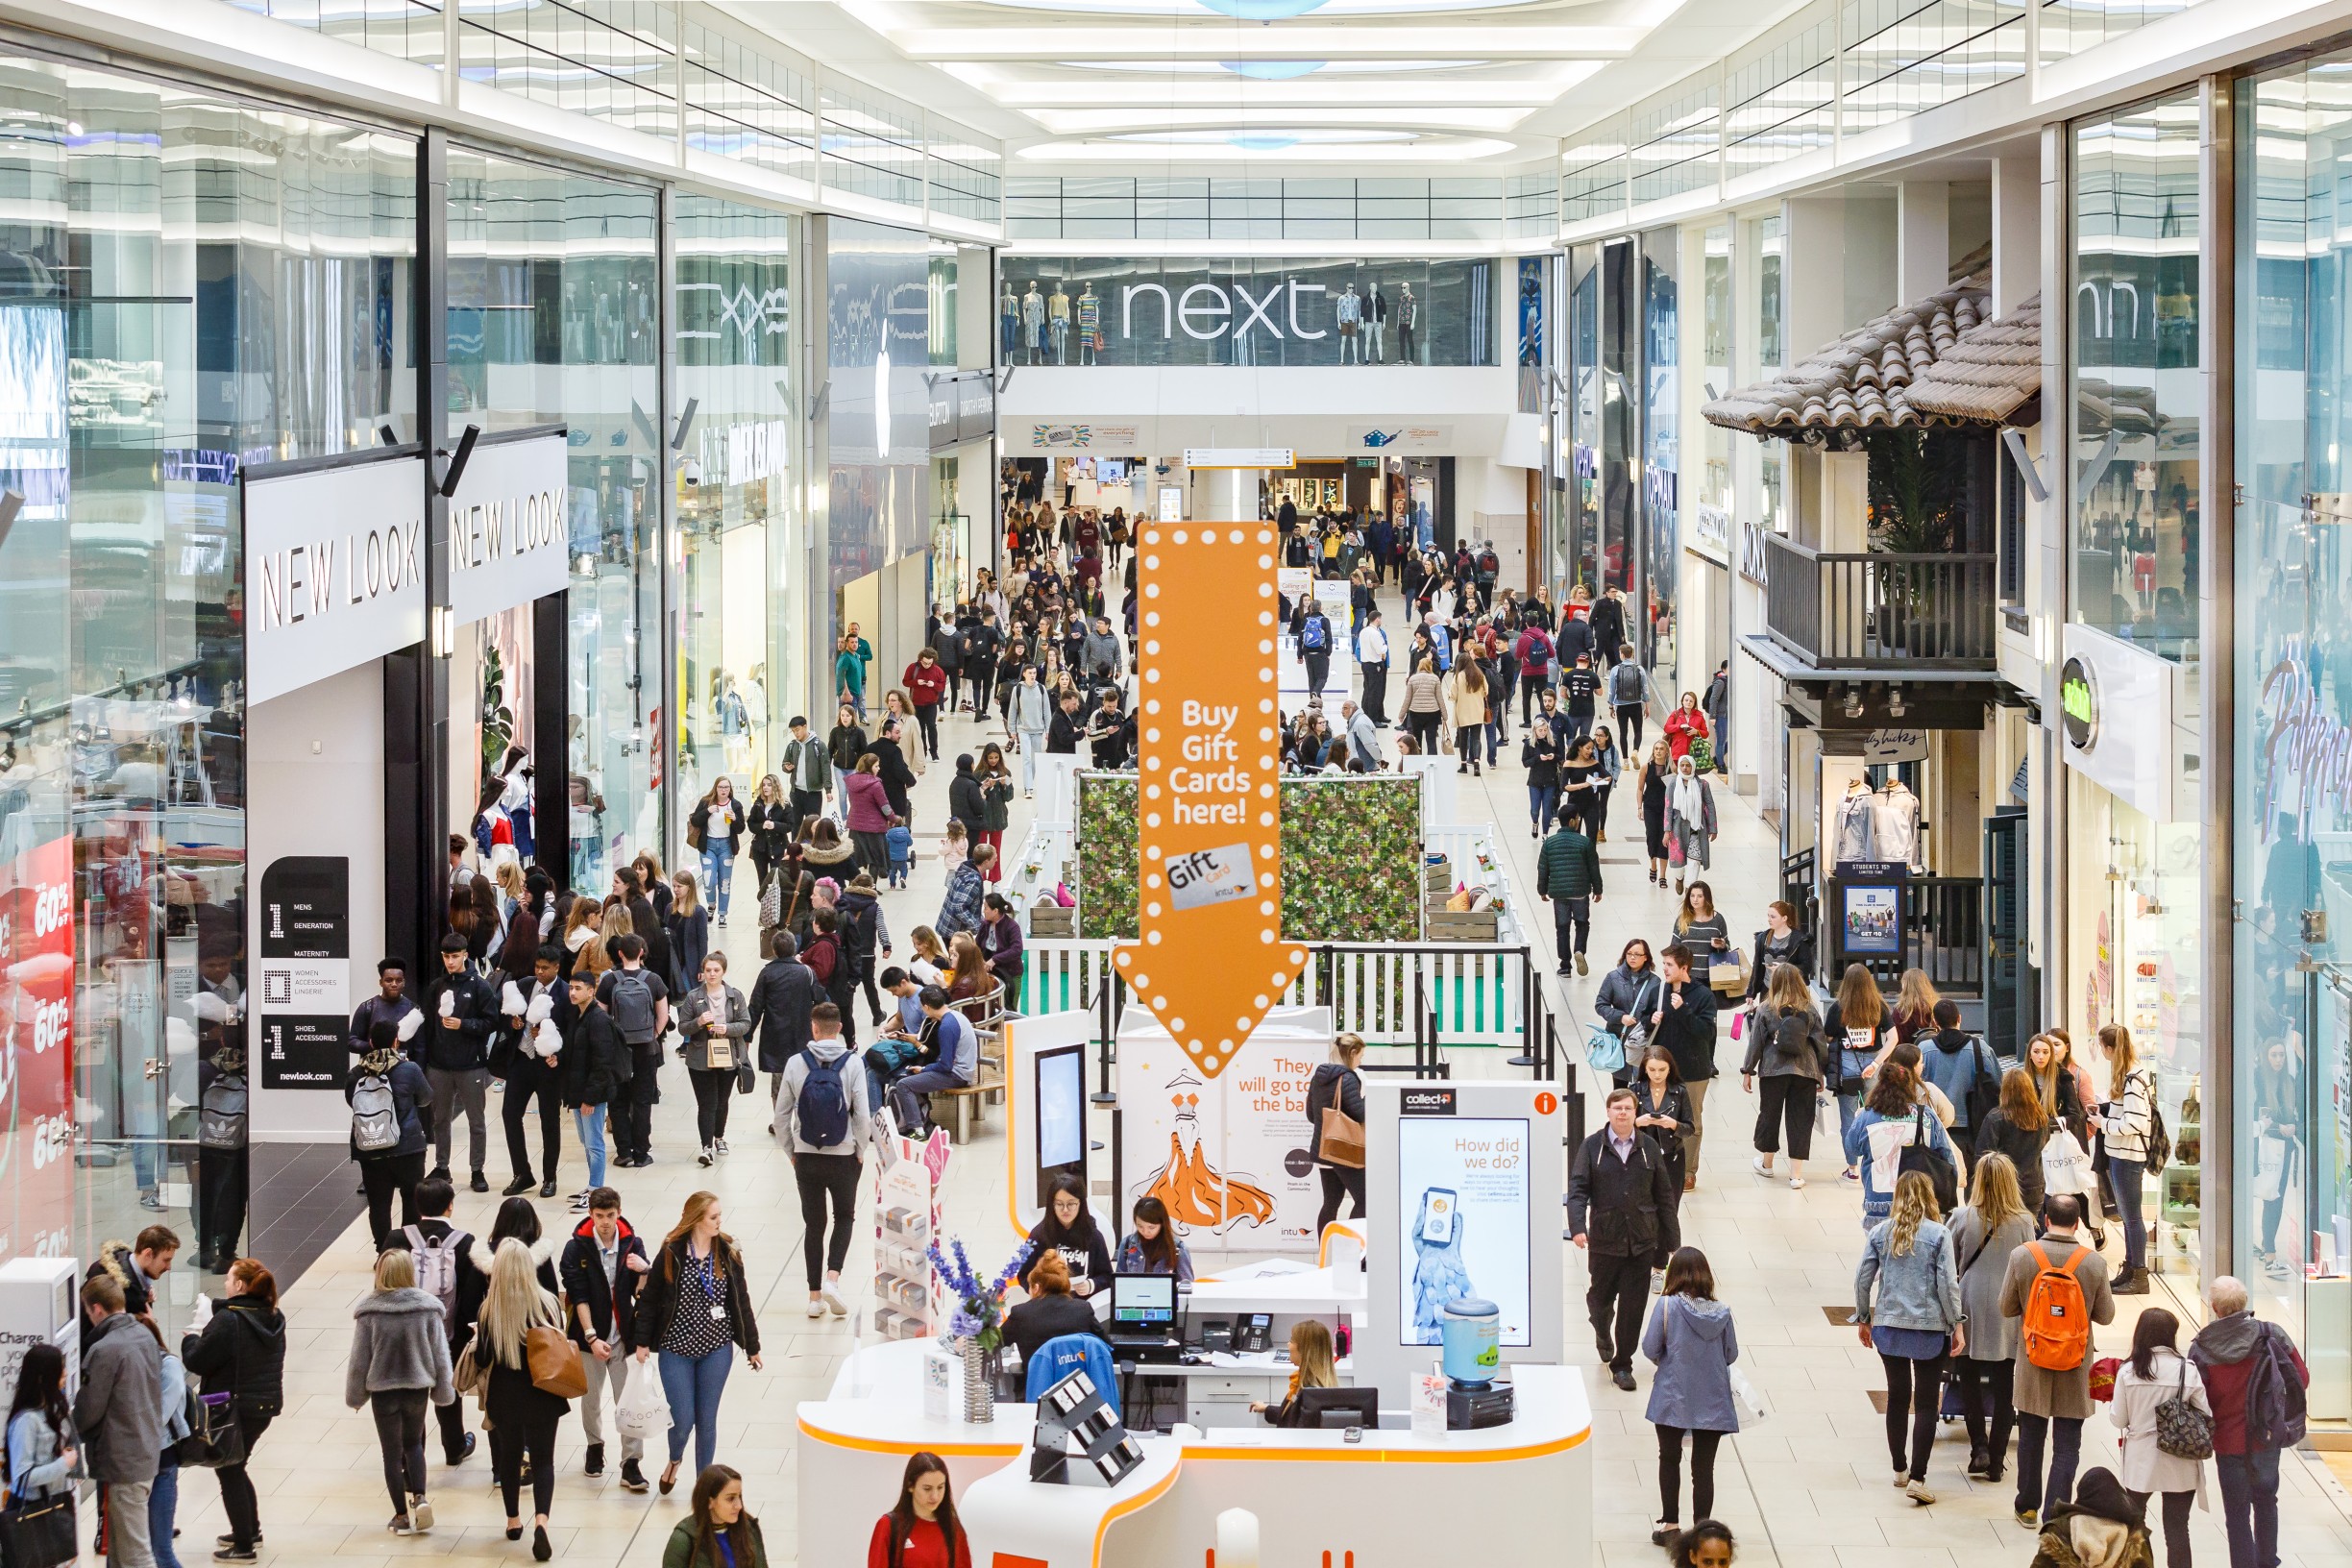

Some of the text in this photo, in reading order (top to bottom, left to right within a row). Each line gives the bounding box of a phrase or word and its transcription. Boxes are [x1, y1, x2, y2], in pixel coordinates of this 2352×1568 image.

[1123, 275, 1326, 340] next
[451, 486, 564, 573] NEW LOOK
[259, 520, 420, 632] NEW LOOK
[1182, 699, 1238, 733] Buy
[1182, 733, 1238, 762] Gift
[1168, 765, 1251, 793] Cards
[1173, 796, 1246, 824] here!
[1167, 851, 1219, 890] Gift
[1205, 865, 1231, 884] Card
[270, 904, 284, 938] 1
[34, 995, 69, 1054] 60%
[280, 1072, 332, 1081] newlook.com
[1273, 1058, 1313, 1077] They
[1239, 1077, 1265, 1092] will
[1270, 1081, 1290, 1095] go
[1253, 1096, 1281, 1112] the
[363, 1138, 387, 1146] adidas
[1456, 1138, 1519, 1152] How did
[1464, 1155, 1519, 1168] we do?
[1281, 1227, 1298, 1236] intu
[0, 1332, 44, 1346] Charge
[1058, 1352, 1078, 1366] intu
